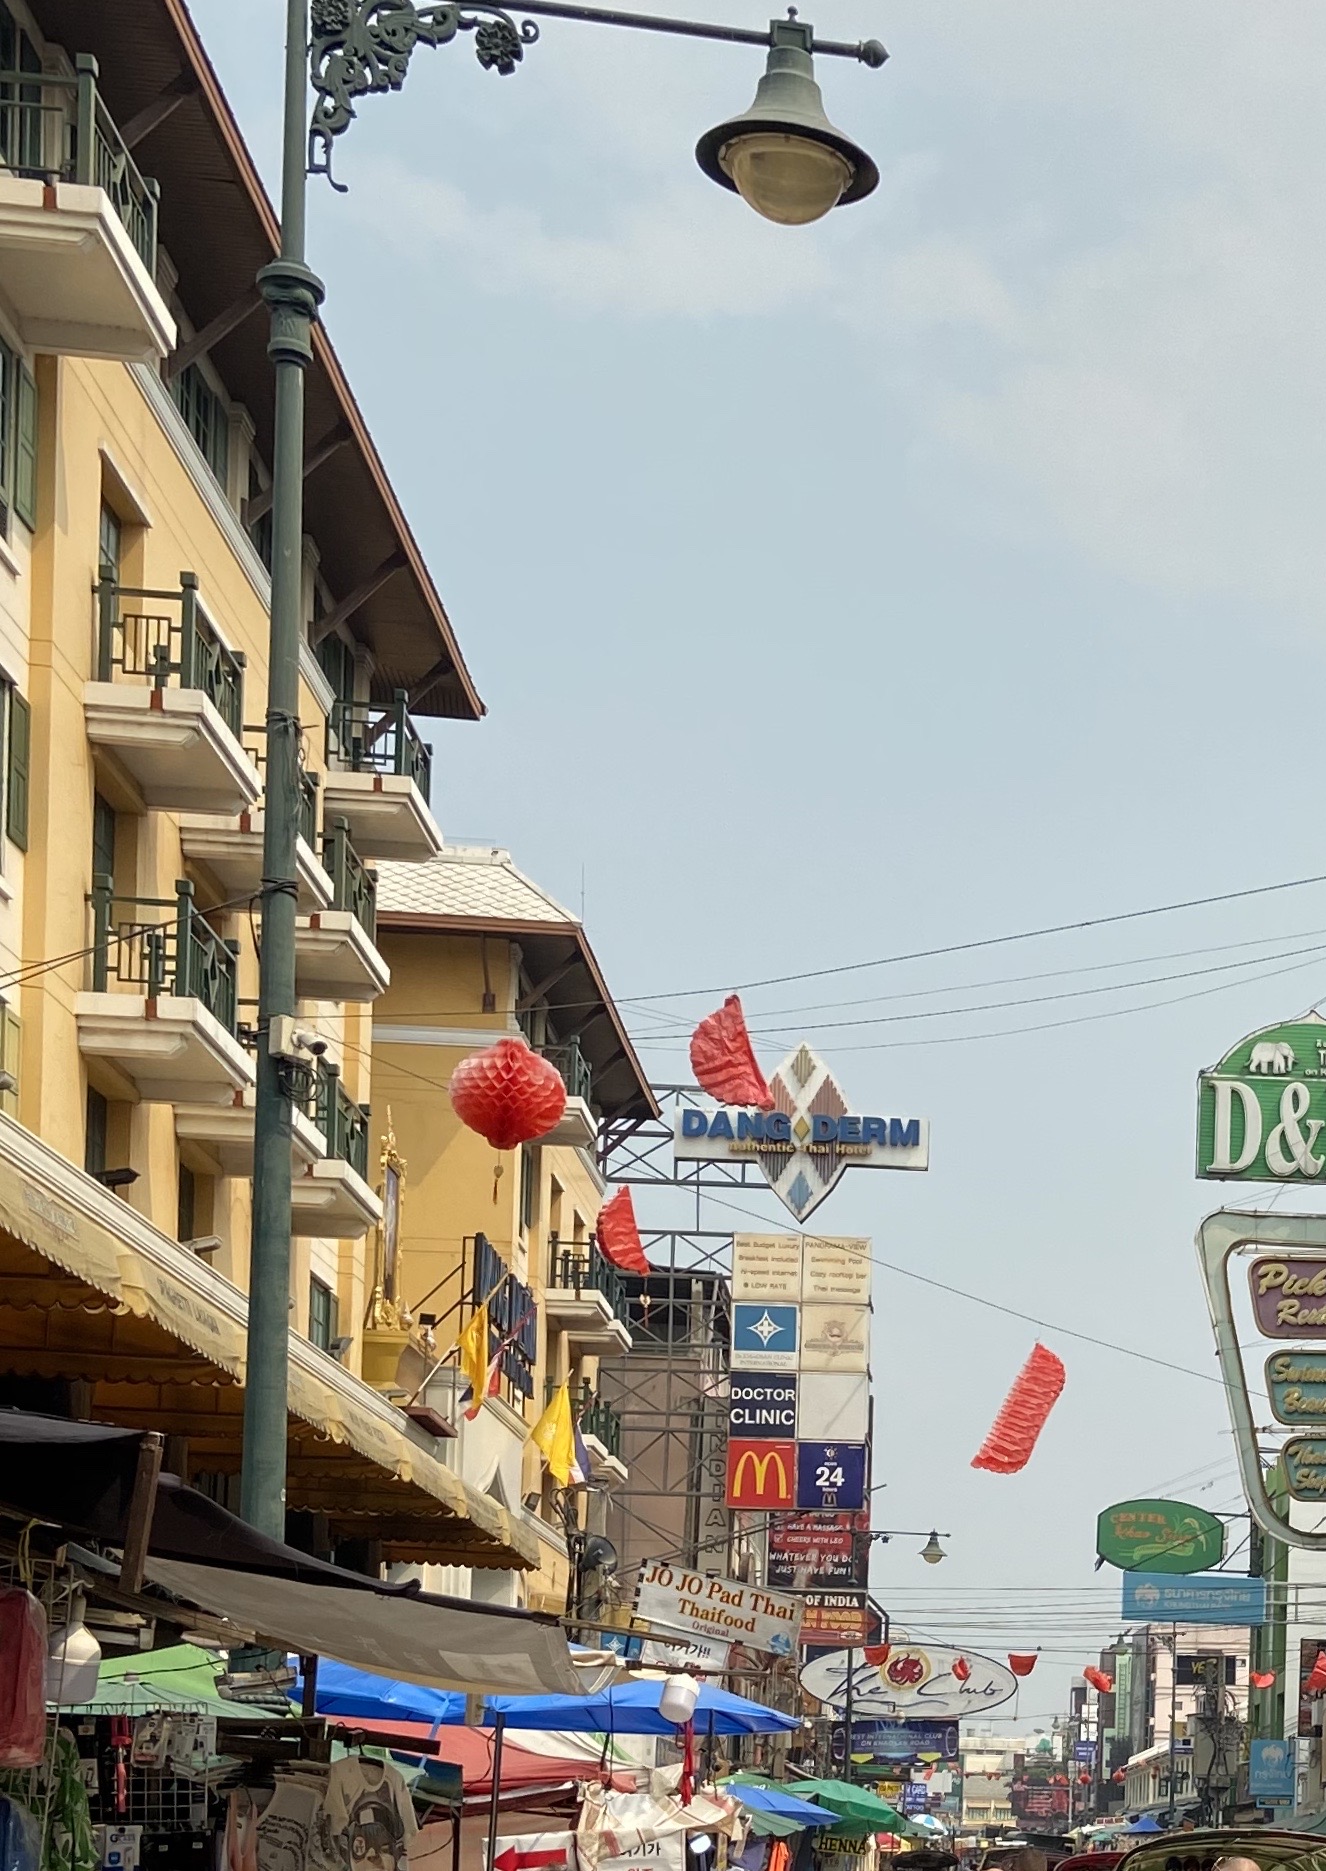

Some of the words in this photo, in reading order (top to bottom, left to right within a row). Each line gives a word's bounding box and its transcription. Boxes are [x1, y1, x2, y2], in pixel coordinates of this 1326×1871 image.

[682, 1108, 792, 1141] DANG
[812, 1114, 921, 1147] DERM
[731, 1387, 796, 1402] DOCTOR
[730, 1408, 795, 1426] CLINIC
[815, 1466, 845, 1487] 24
[769, 1551, 817, 1562] WHATEVER
[819, 1554, 839, 1563] YOU
[775, 1564, 797, 1574] JUST
[800, 1566, 825, 1575] HAVE
[646, 1565, 674, 1588] JO
[676, 1573, 704, 1597] JO
[706, 1581, 744, 1608] Pad
[750, 1593, 796, 1622] Thai
[805, 1595, 822, 1605] OF
[823, 1595, 860, 1608] INDIA
[678, 1597, 756, 1633] Thaifood
[691, 1620, 730, 1637] Original
[818, 1833, 869, 1856] HENNA
